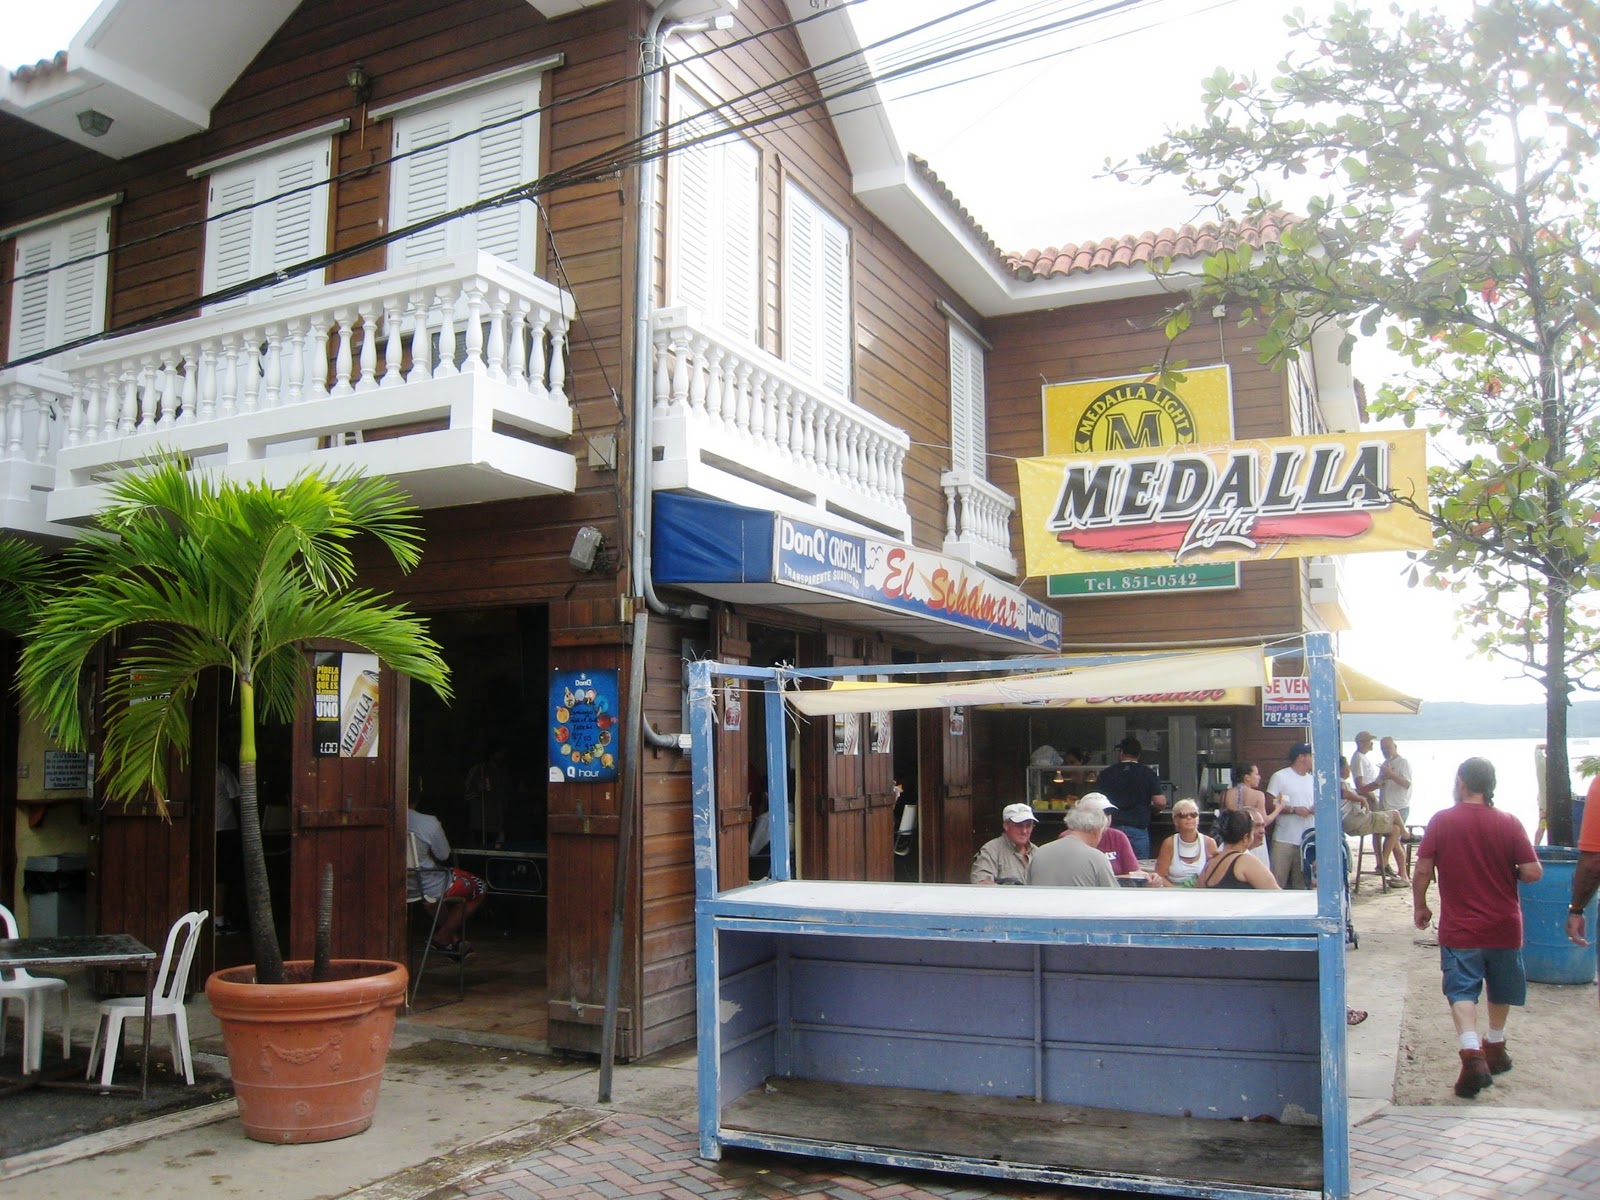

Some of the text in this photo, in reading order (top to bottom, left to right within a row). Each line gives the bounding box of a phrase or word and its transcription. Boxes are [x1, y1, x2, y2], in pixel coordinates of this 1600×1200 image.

[1078, 386, 1190, 435] MEDALLA LIGHT
[1105, 409, 1164, 450] M
[1048, 440, 1391, 532] MEDALLA
[781, 520, 862, 574] DonQ CRISTAL
[1174, 507, 1257, 562] Light
[783, 562, 832, 585] TRANSPARENTE
[882, 547, 1018, 630] El Schamar
[1084, 573, 1198, 591] Tel. 851-0542
[316, 682, 339, 690] QUE ES
[1265, 679, 1281, 694] SE
[316, 702, 339, 717] UNO
[340, 693, 373, 756] MEDALLA
[567, 766, 576, 778] Q
[578, 769, 600, 777] hour
